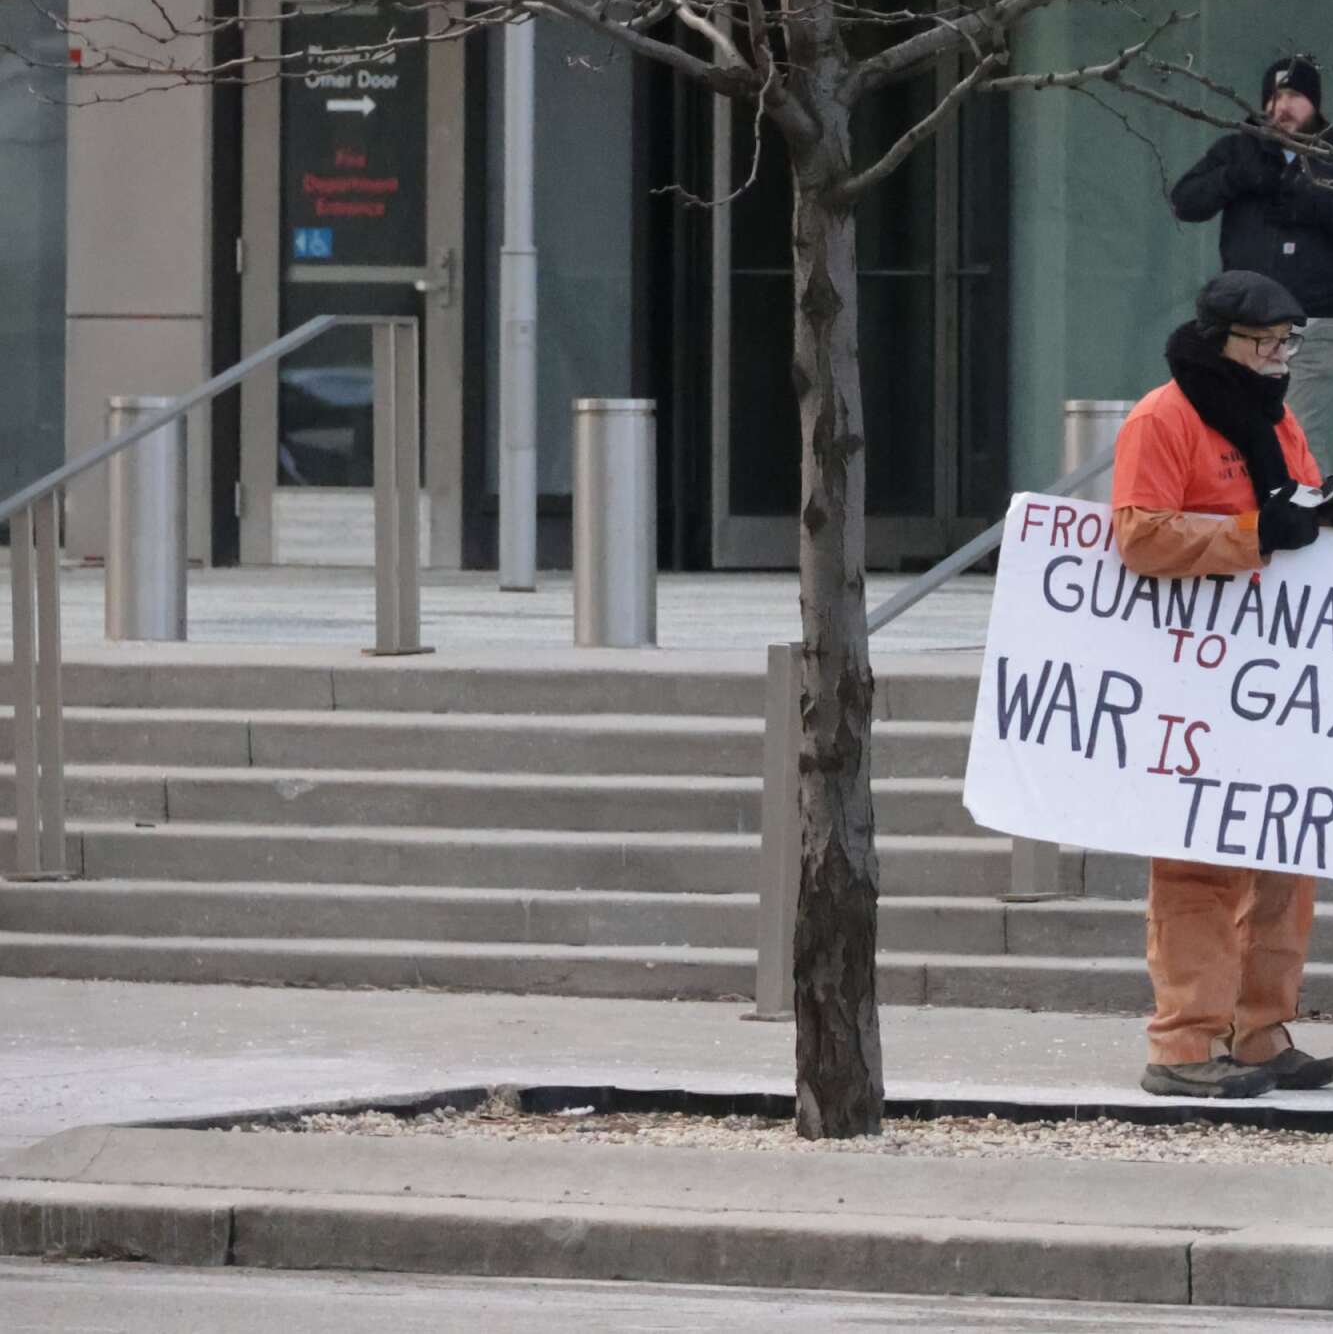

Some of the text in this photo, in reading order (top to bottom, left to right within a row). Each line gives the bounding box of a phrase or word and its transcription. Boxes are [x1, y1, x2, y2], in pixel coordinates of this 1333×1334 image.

[358, 69, 399, 89] Door
[1167, 628, 1228, 669] TO
[997, 656, 1144, 770] WAR
[1146, 713, 1212, 777] IS
